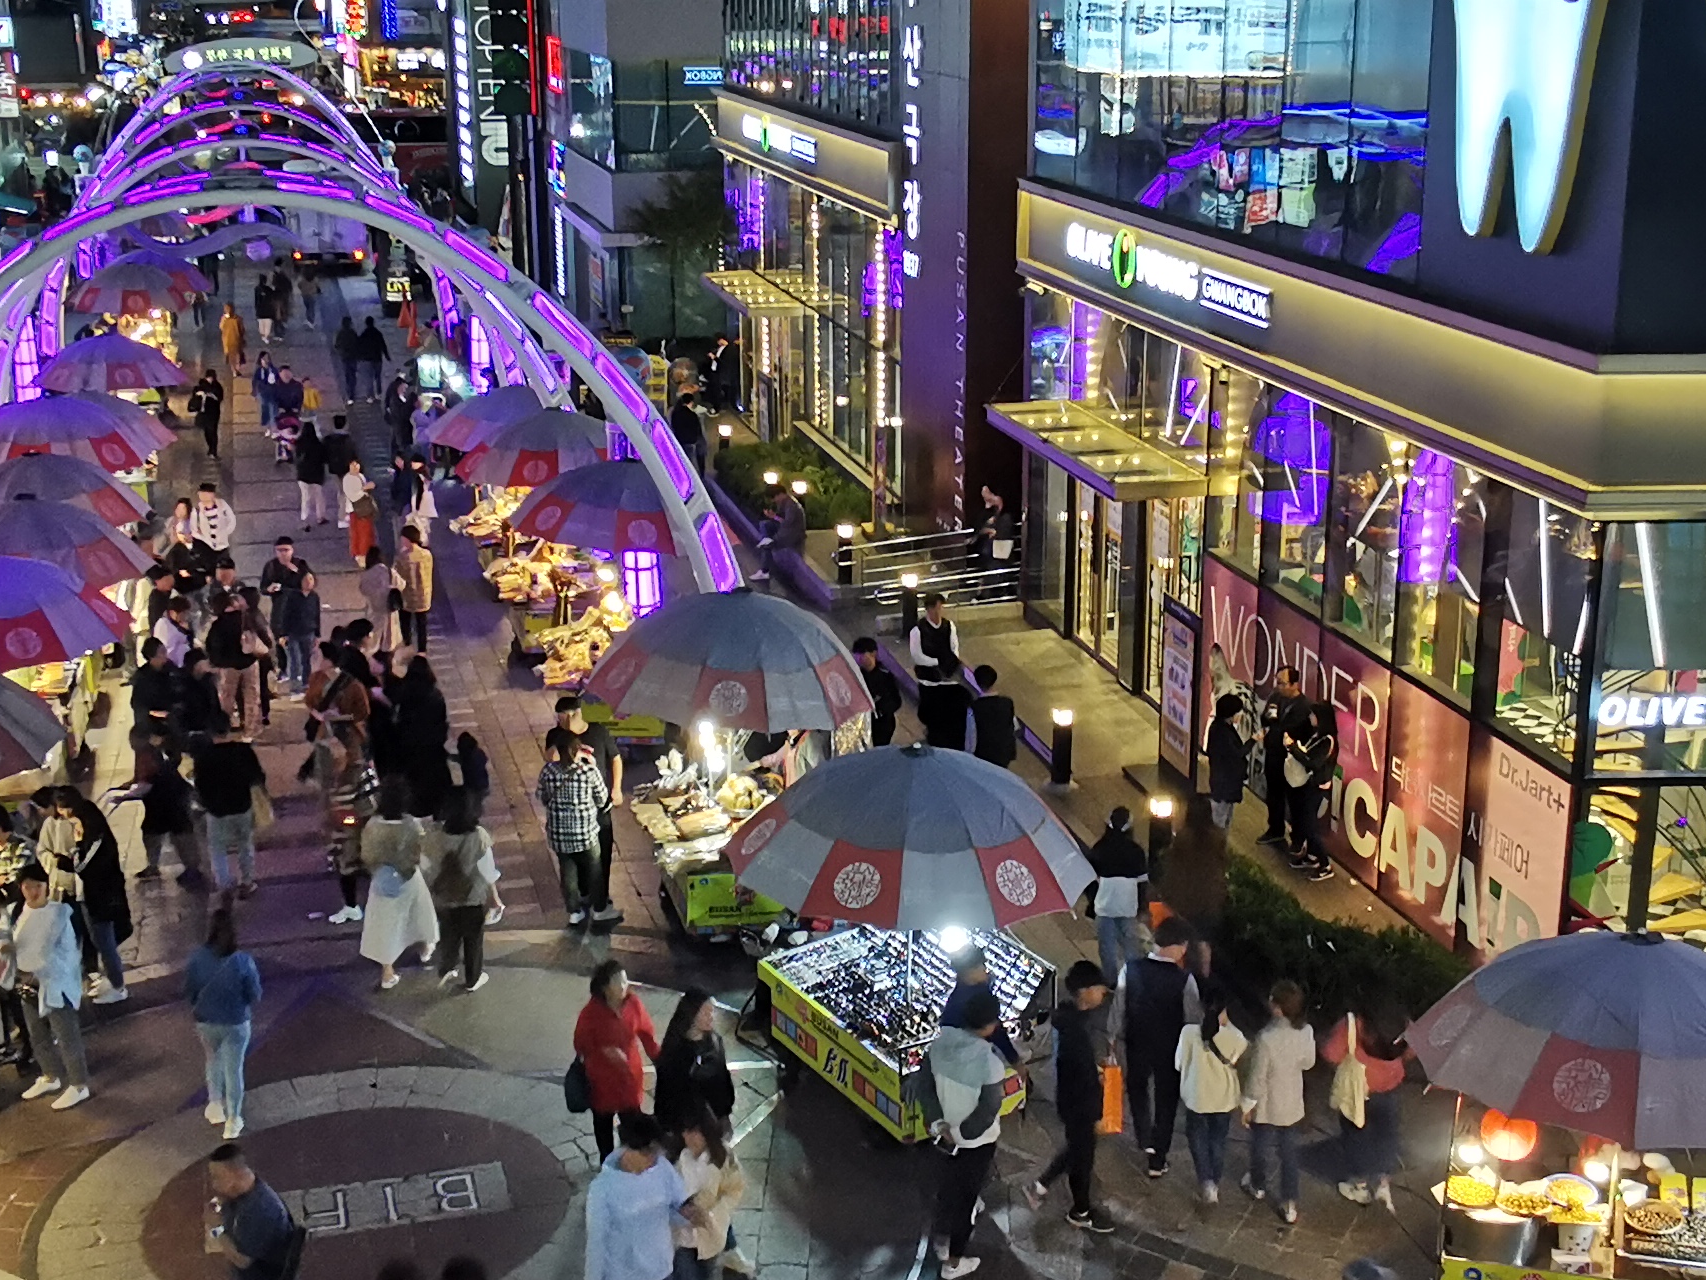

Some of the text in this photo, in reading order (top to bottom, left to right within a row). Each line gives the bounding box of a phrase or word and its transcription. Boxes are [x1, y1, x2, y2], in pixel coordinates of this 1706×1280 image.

[954, 230, 968, 354] PUSAN
[1066, 222, 1268, 320] OLIVE YOUNG GWANGBOK
[1210, 586, 1381, 772] WONDER
[1498, 750, 1566, 815] Dr.Jart+
